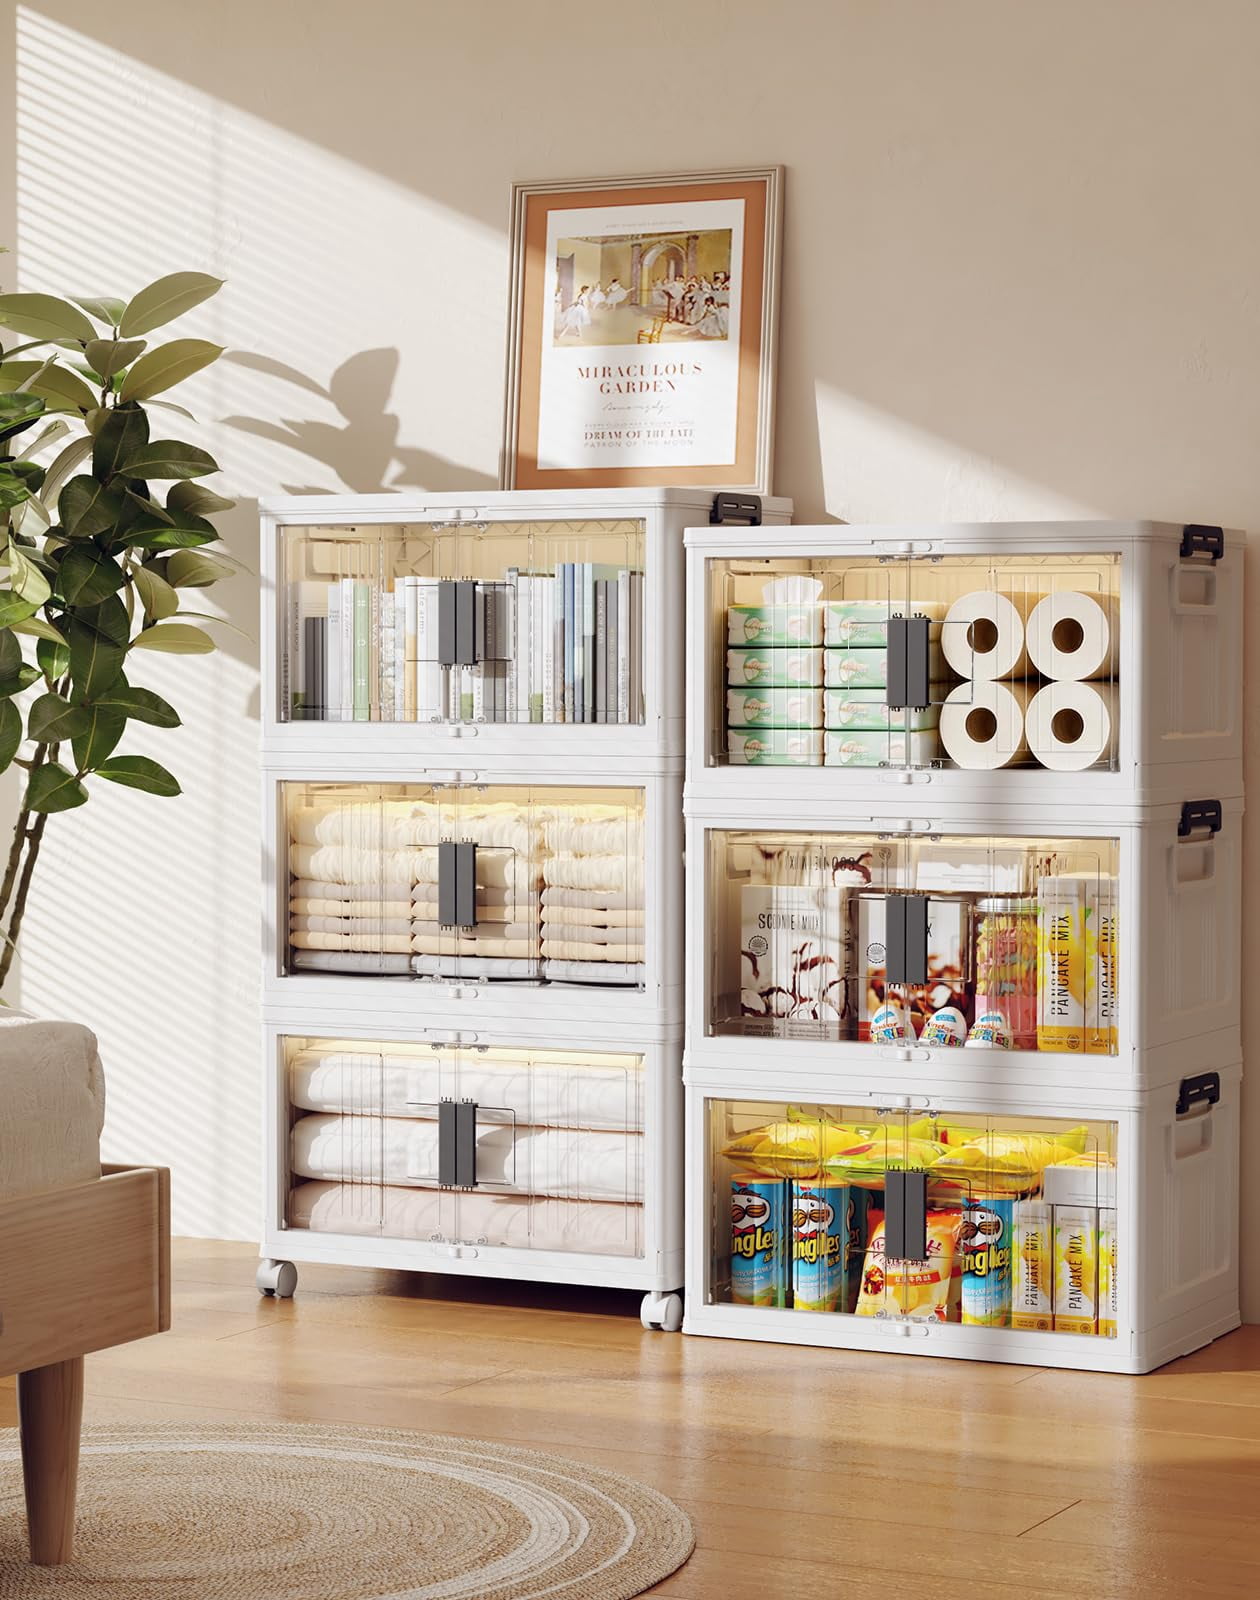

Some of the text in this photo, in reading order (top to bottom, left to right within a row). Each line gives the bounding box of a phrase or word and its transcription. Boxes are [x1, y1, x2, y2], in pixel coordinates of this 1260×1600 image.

[578, 363, 703, 379] MIRACULOUS
[599, 380, 677, 395] GARDEN
[584, 431, 622, 441] DREAM
[626, 430, 641, 439] OF
[647, 429, 665, 439] THE
[626, 440, 638, 448] OF
[664, 439, 694, 447] MOON
[1056, 915, 1069, 1016] PANCAKE MIX
[1028, 1232, 1039, 1251] MIX
[1069, 1234, 1082, 1255] MIX
[1028, 1257, 1038, 1306] PANCAKE
[1069, 1260, 1082, 1310] PANCAKE
